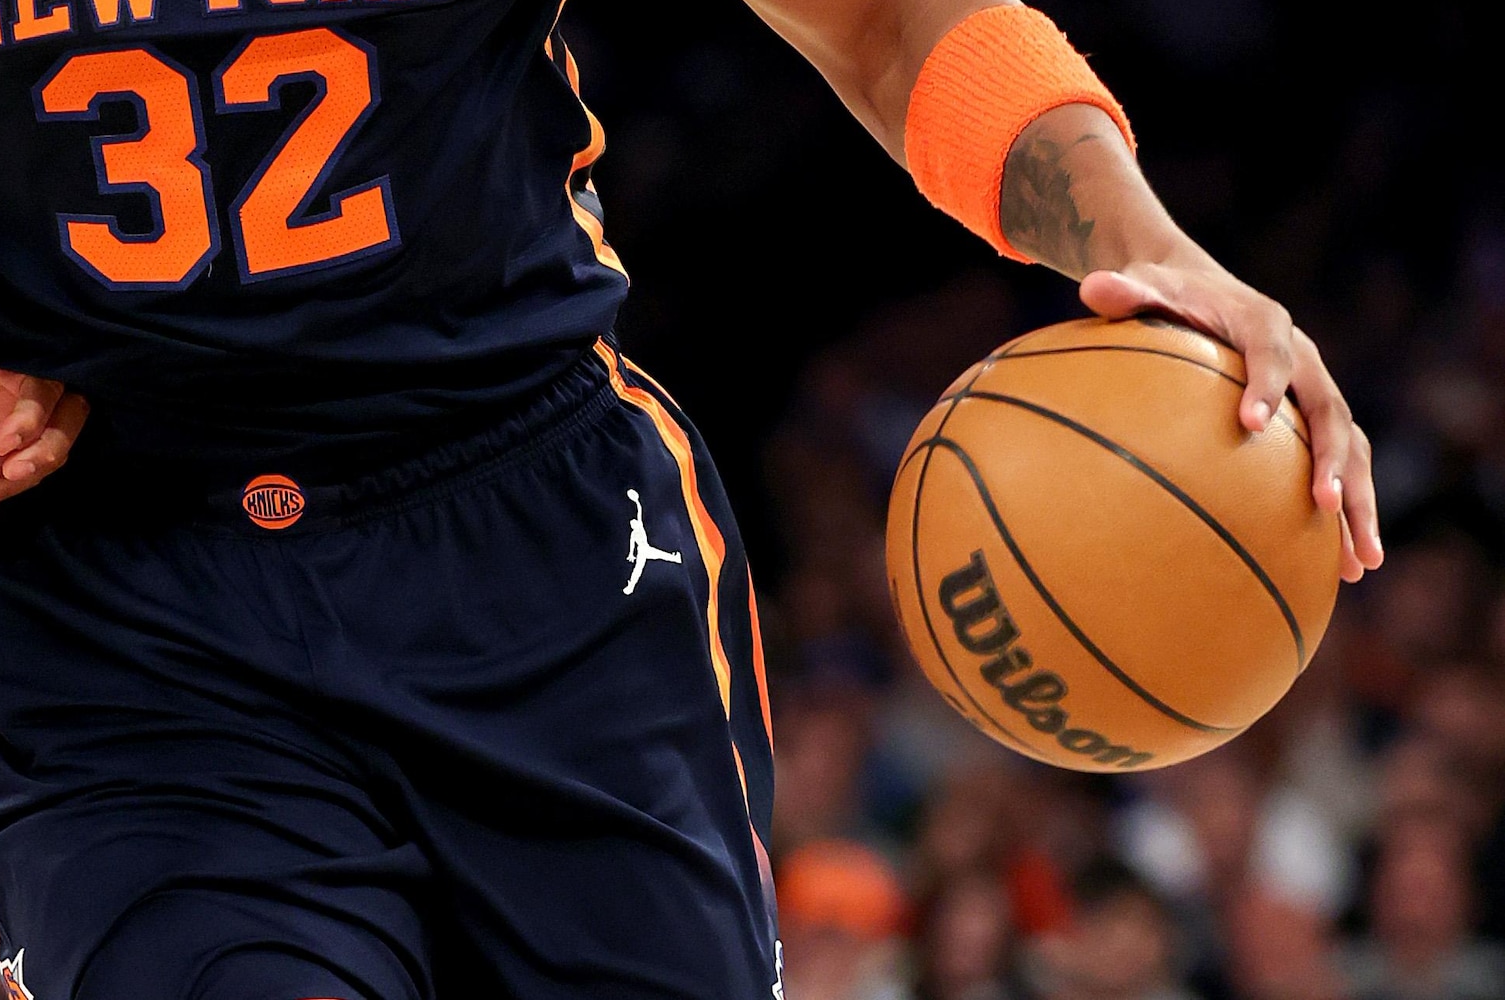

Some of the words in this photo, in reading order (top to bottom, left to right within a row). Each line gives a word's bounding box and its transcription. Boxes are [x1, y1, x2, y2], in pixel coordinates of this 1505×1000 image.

[32, 23, 401, 291] 32
[246, 489, 301, 518] KNICKS
[937, 547, 1154, 768] Wilson
